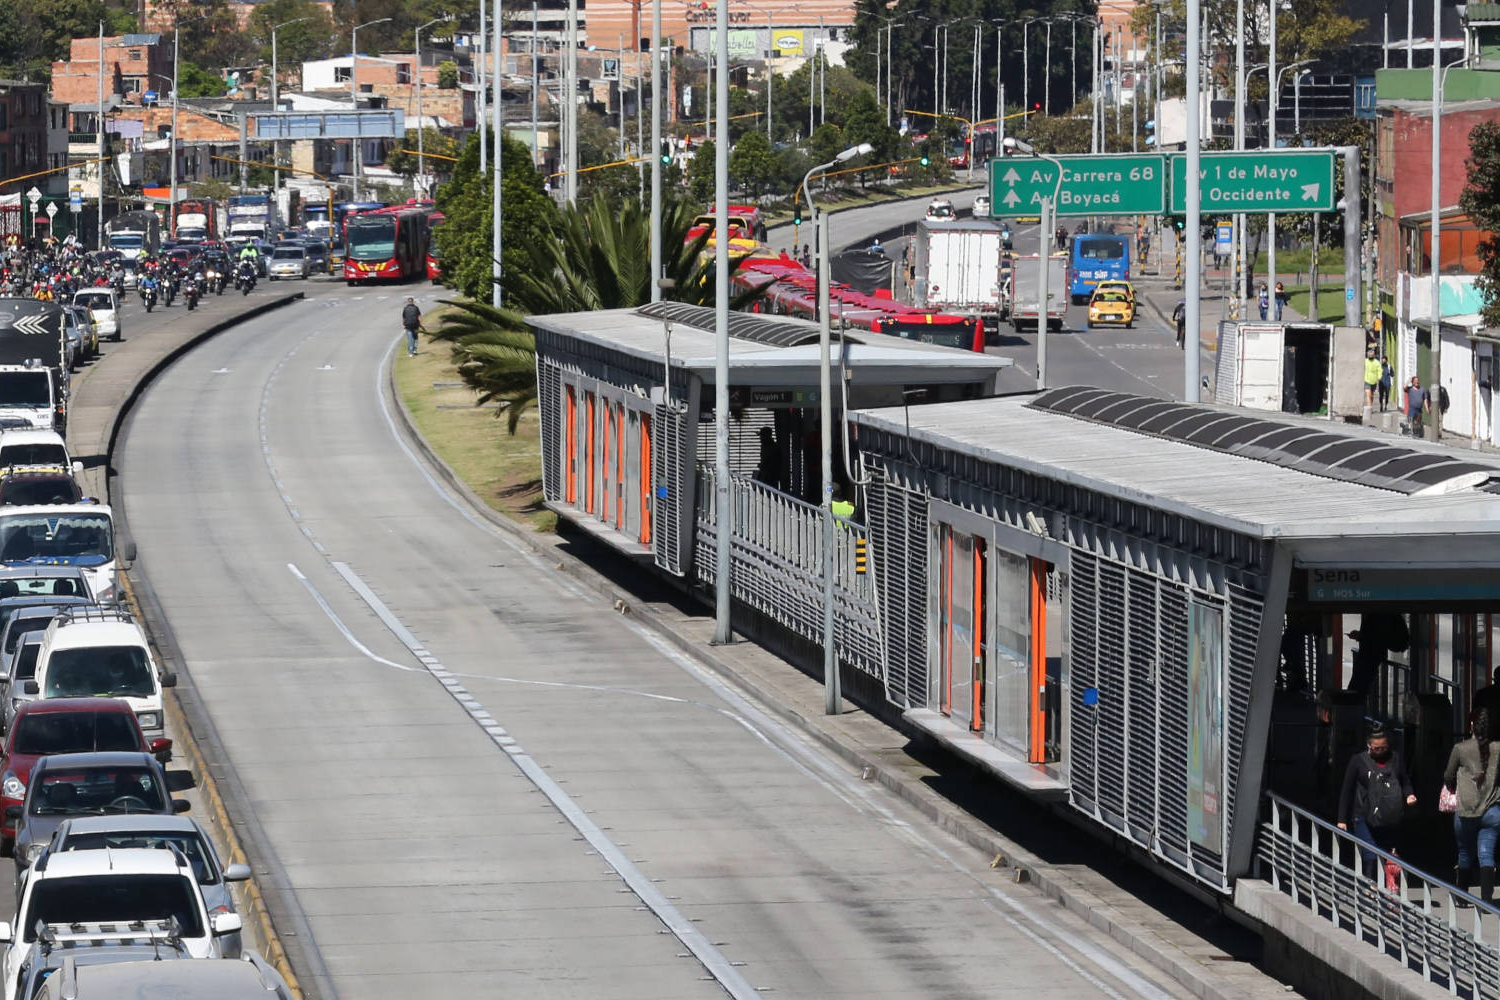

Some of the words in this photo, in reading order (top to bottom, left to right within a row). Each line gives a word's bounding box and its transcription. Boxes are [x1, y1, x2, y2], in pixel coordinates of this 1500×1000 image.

[1030, 170, 1053, 183] Av
[1062, 169, 1122, 183] Carrera
[1129, 167, 1154, 181] 68
[1215, 166, 1221, 180] 1
[1228, 167, 1247, 180] de
[1254, 165, 1298, 181] Mayo
[1060, 190, 1120, 207] Boyacá
[1210, 187, 1291, 201] Occidente
[1314, 568, 1360, 582] Sena
